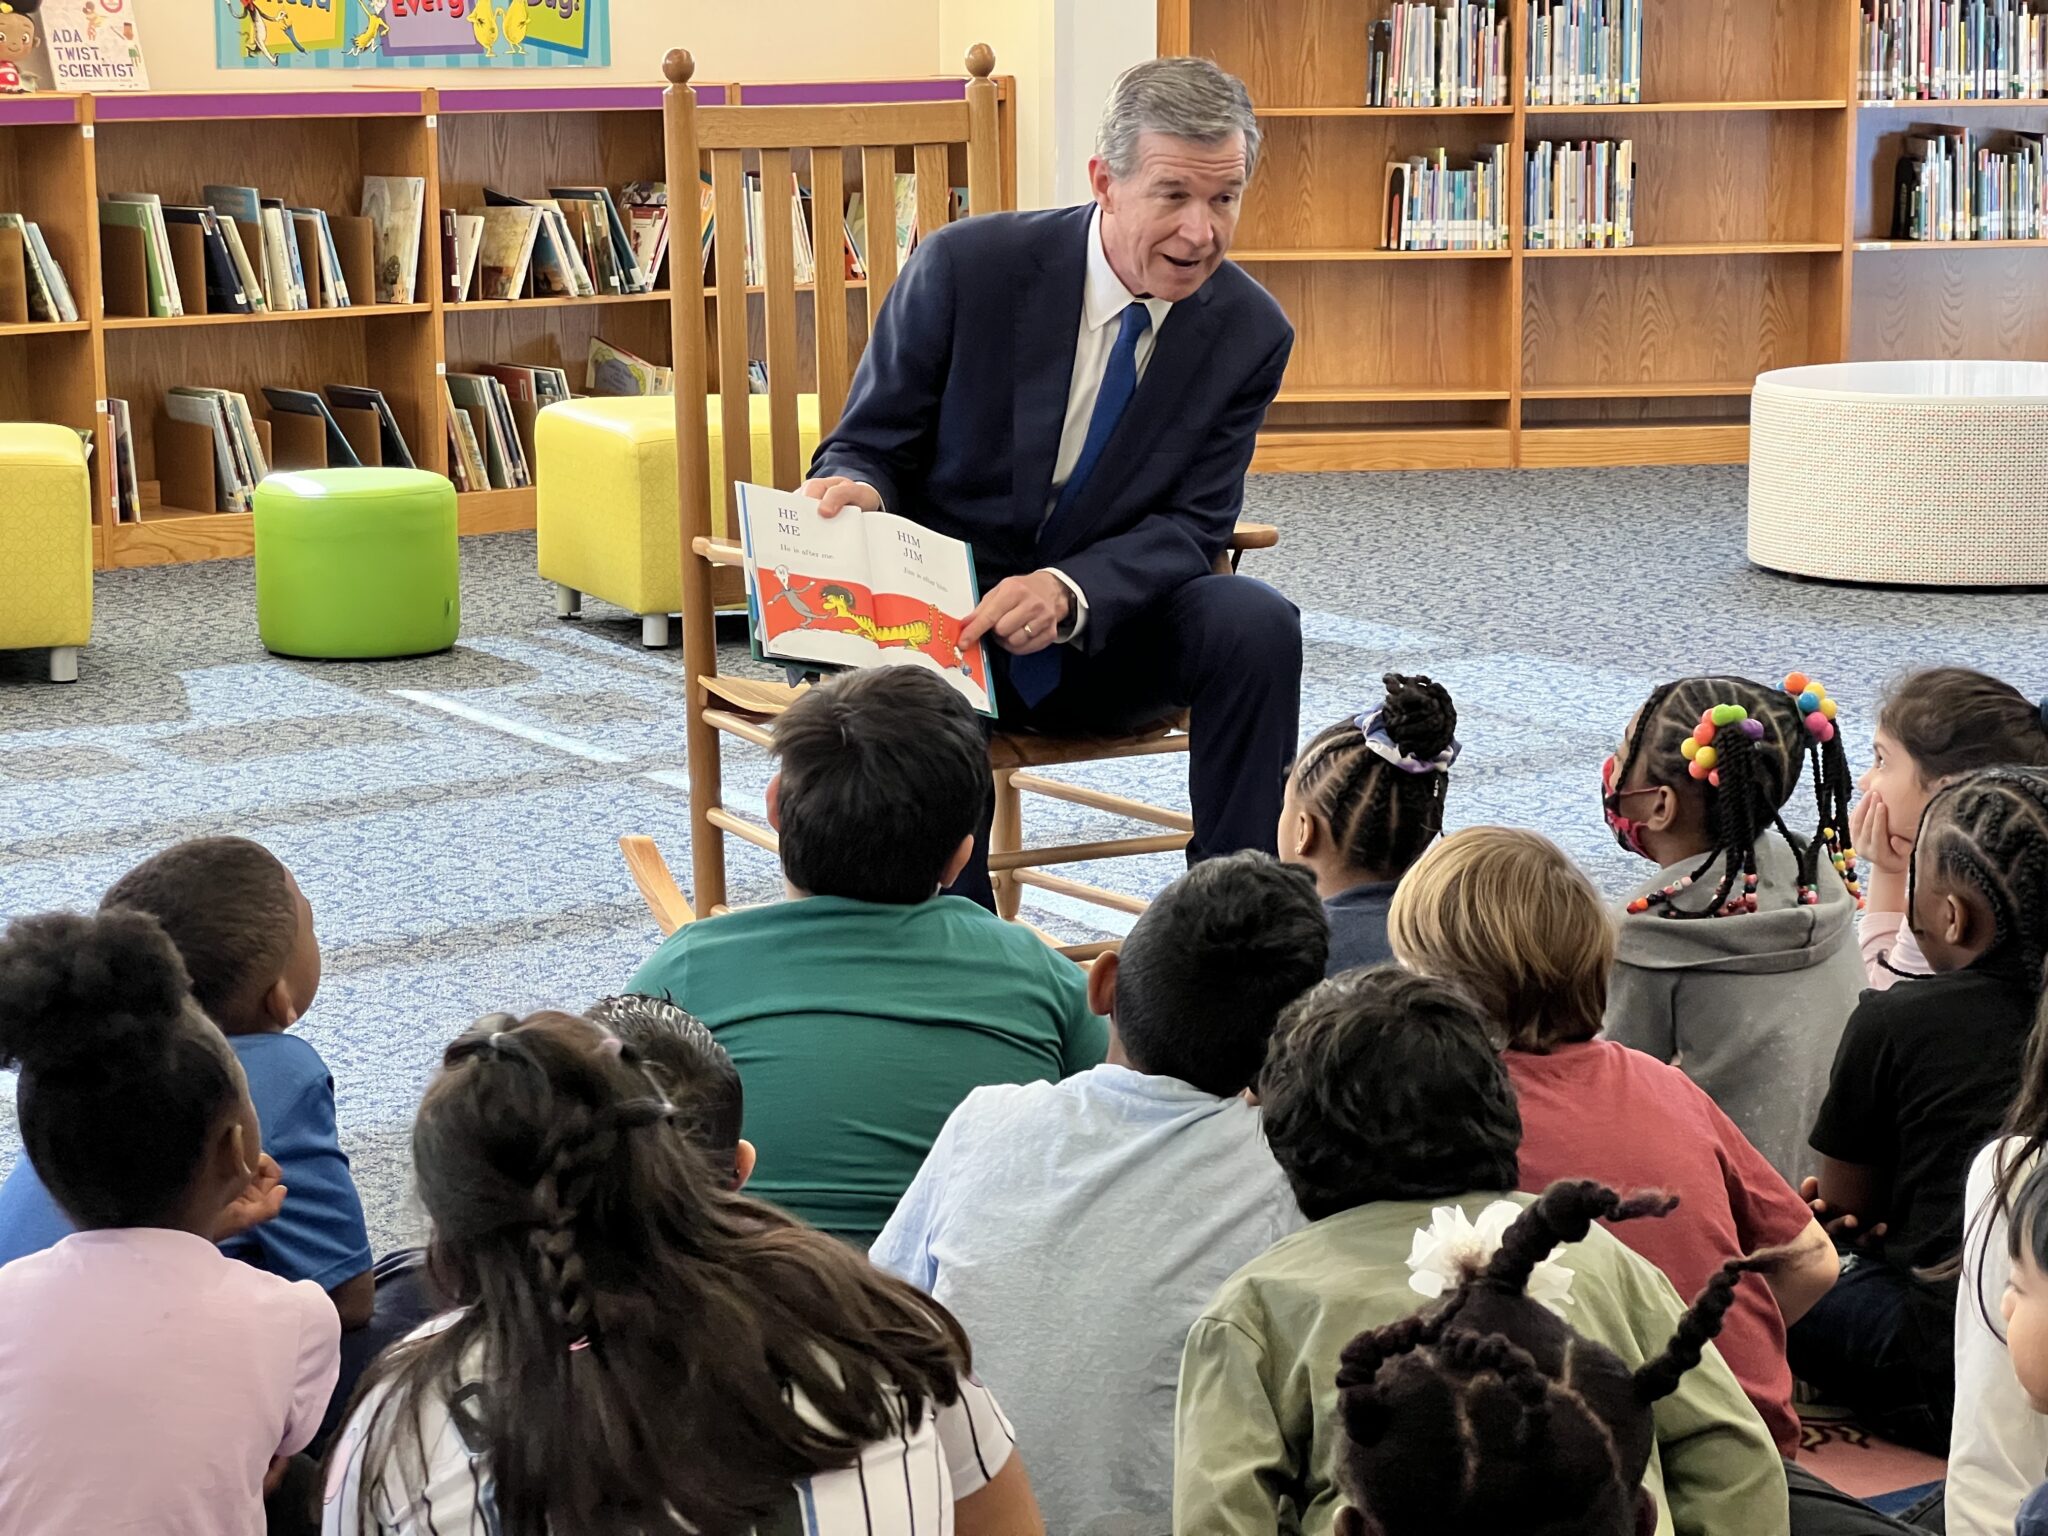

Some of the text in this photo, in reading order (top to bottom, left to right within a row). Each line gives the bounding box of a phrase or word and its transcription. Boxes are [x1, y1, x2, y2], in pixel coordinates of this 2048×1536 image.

[53, 29, 83, 43] ADA
[54, 47, 105, 63] TWIST,
[58, 63, 134, 78] SCIENTIST
[778, 507, 799, 521] HE
[778, 522, 801, 537] ME
[897, 530, 921, 549] HIM
[903, 547, 923, 565] JIM
